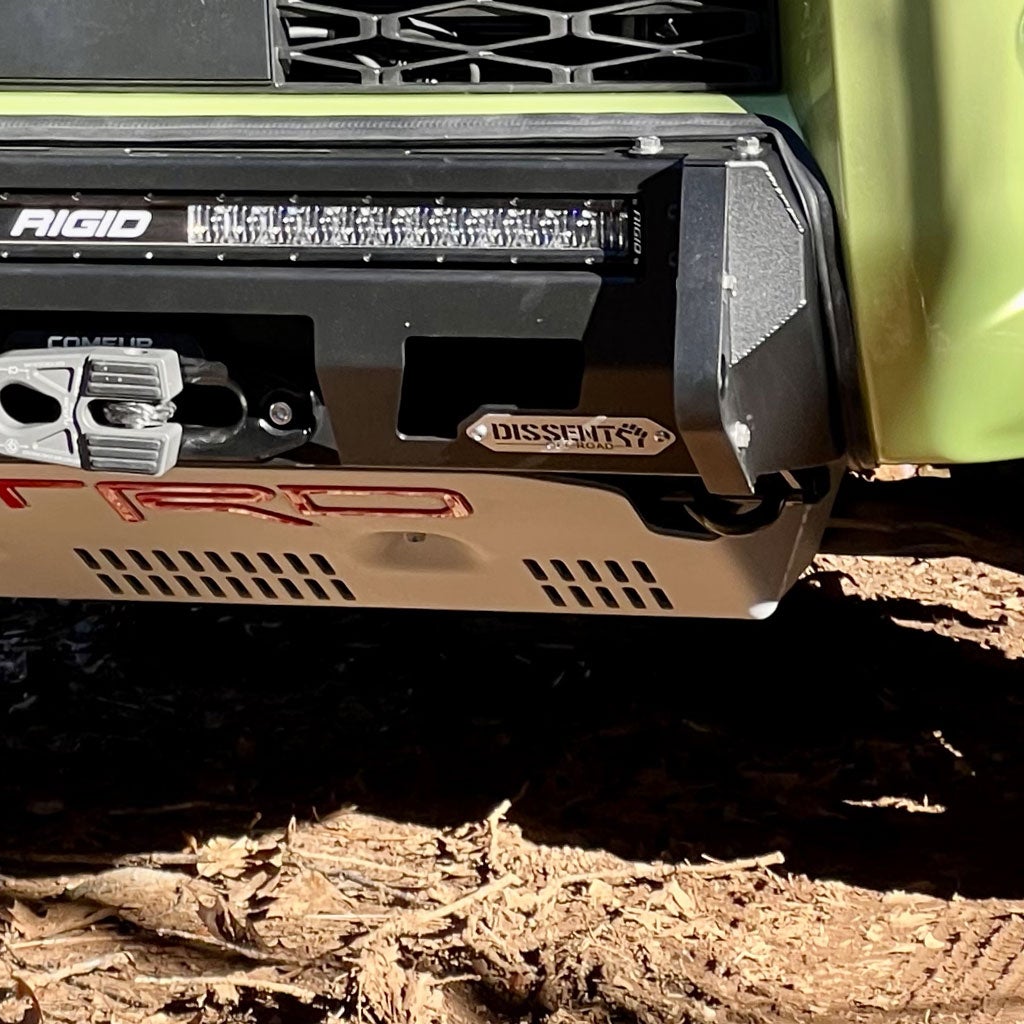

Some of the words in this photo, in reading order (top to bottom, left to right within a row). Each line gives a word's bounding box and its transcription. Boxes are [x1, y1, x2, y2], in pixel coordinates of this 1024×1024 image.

[9, 208, 153, 238] RIGID
[632, 209, 642, 255] RIGID
[47, 335, 154, 348] COMEUP
[491, 423, 616, 442] DISSENT
